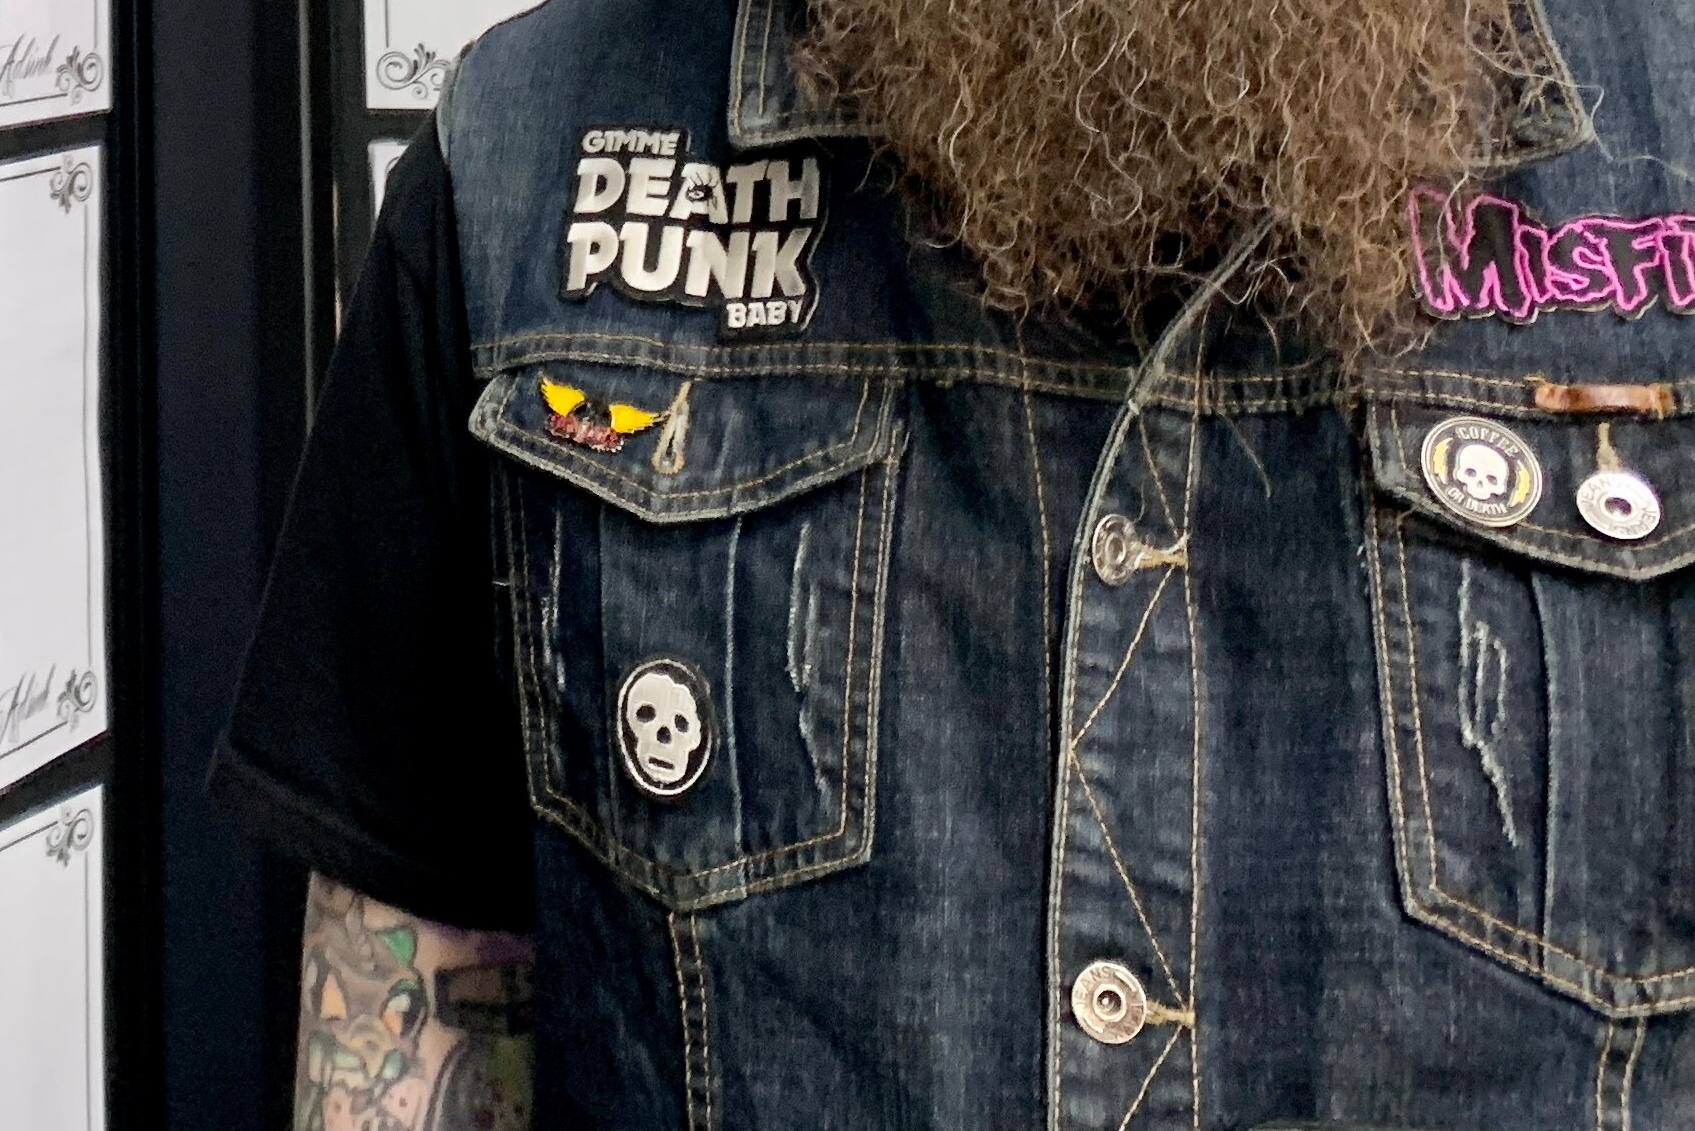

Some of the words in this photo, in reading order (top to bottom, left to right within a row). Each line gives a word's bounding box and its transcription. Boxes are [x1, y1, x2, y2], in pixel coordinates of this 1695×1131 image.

[582, 130, 680, 155] GIMME
[573, 158, 820, 224] DEATH
[566, 222, 812, 298] PUNK
[726, 300, 806, 329] BABY
[1455, 425, 1518, 458] COFFEE
[1446, 486, 1465, 504] OR
[1462, 498, 1508, 516] DEATH
